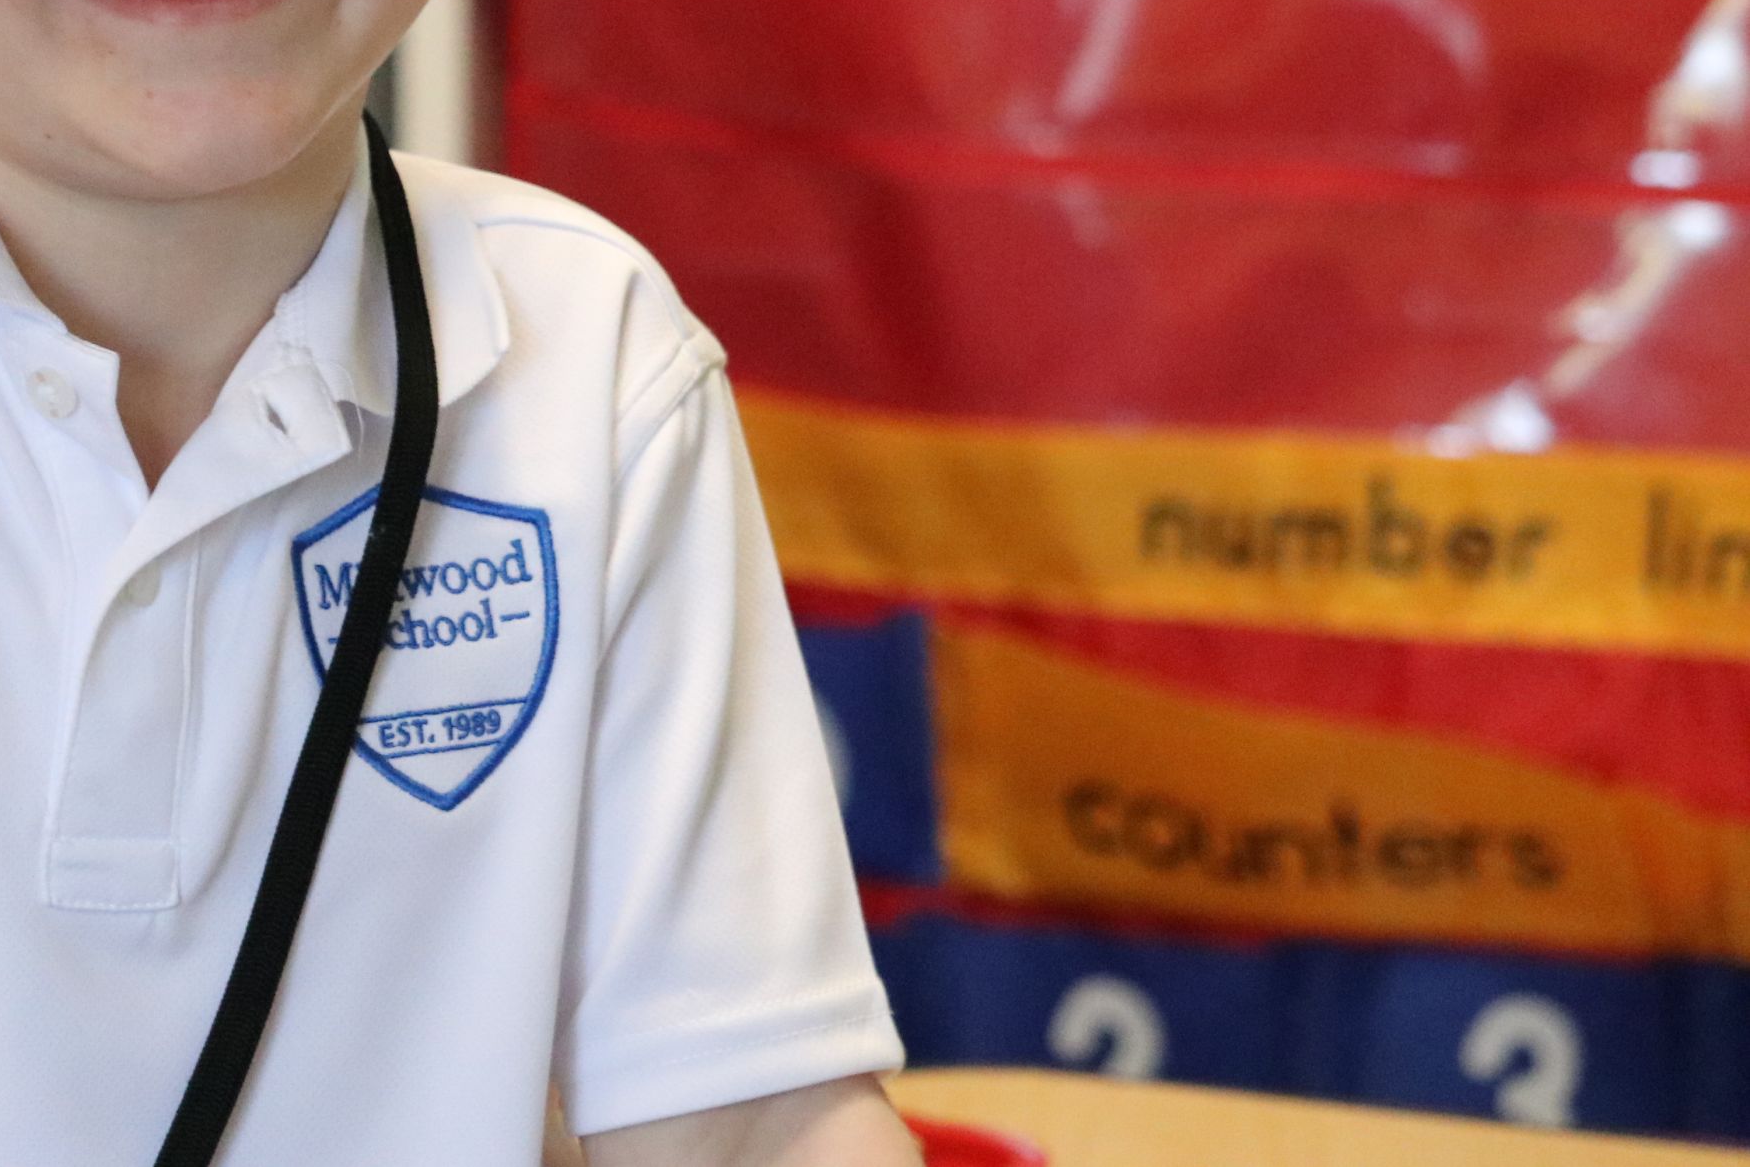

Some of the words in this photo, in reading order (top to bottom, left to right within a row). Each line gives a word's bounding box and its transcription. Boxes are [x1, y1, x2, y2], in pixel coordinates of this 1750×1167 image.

[1138, 472, 1556, 585] number
[314, 539, 533, 610] Mwood
[381, 597, 498, 650] chool
[377, 718, 435, 749] EST.
[441, 708, 501, 742] 1989
[1061, 777, 1566, 891] counters
